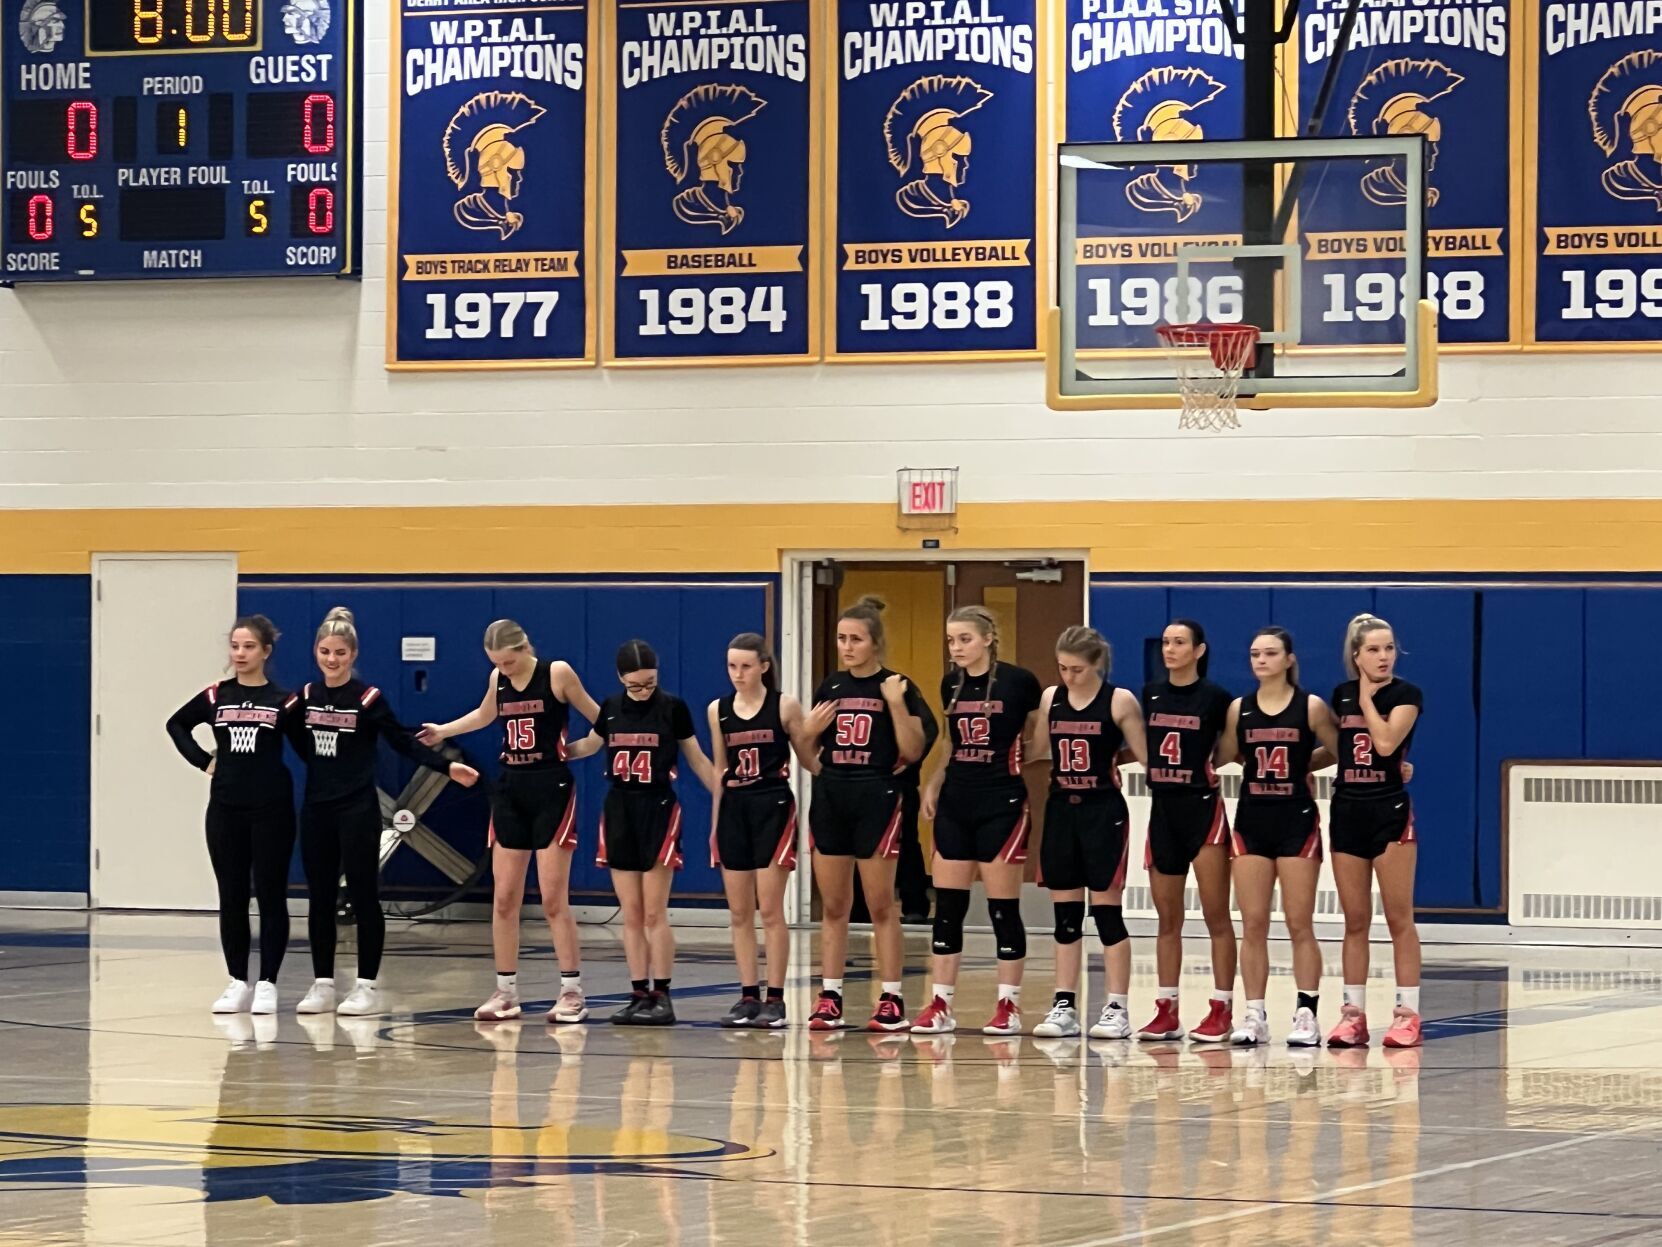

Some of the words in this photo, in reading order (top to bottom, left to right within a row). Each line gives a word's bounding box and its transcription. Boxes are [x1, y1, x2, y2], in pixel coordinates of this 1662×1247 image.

[648, 8, 777, 37] W.P.I.A.L.
[870, 0, 1004, 27] W.P.I.A.L.
[430, 17, 555, 45] W.P.I.A.L.
[1071, 16, 1245, 73] CHAMPION
[1305, 6, 1506, 64] CHAMPIONS
[622, 33, 806, 89] CHAMPIONS
[844, 24, 1033, 80] CHAMPIONS
[20, 62, 91, 91] HOME
[250, 54, 332, 84] GUEST
[406, 43, 583, 96] CHAMPIONS
[143, 76, 203, 95] PERIOD
[67, 102, 97, 159] 0
[178, 108, 186, 147] 1
[304, 94, 334, 153] 0
[7, 170, 60, 189] FOULS
[118, 167, 181, 186] PLAYER
[188, 165, 231, 185] FOUL
[29, 194, 52, 240] 0
[80, 204, 97, 237] 5
[249, 200, 267, 232] 5
[309, 188, 333, 233] 0
[854, 248, 903, 264] BOYS
[908, 246, 1020, 263] VOLLEYBALL
[1083, 243, 1132, 259] BOYS
[1317, 237, 1367, 254] BOYS
[1373, 235, 1492, 253] VOLYBALL
[1556, 232, 1608, 249] BOYS
[7, 252, 60, 271] SCORE
[143, 250, 202, 269] MATCH
[416, 260, 447, 275] BOYS
[451, 259, 490, 274] TRACK
[494, 258, 530, 273] RELAY
[534, 257, 568, 272] TEAM
[666, 252, 757, 269] BASEBALL
[425, 291, 560, 339] 1977
[639, 286, 787, 335] 1984
[860, 280, 1014, 330] 1988
[1088, 276, 1243, 326] 1986
[912, 481, 945, 510] EXIT
[507, 718, 535, 750] 15
[835, 713, 872, 746] 50
[957, 717, 990, 745] 12
[1058, 738, 1090, 772] 13
[1160, 732, 1181, 765] 4
[1255, 746, 1289, 778] 14
[1353, 733, 1372, 766] 2
[613, 750, 651, 783] 44
